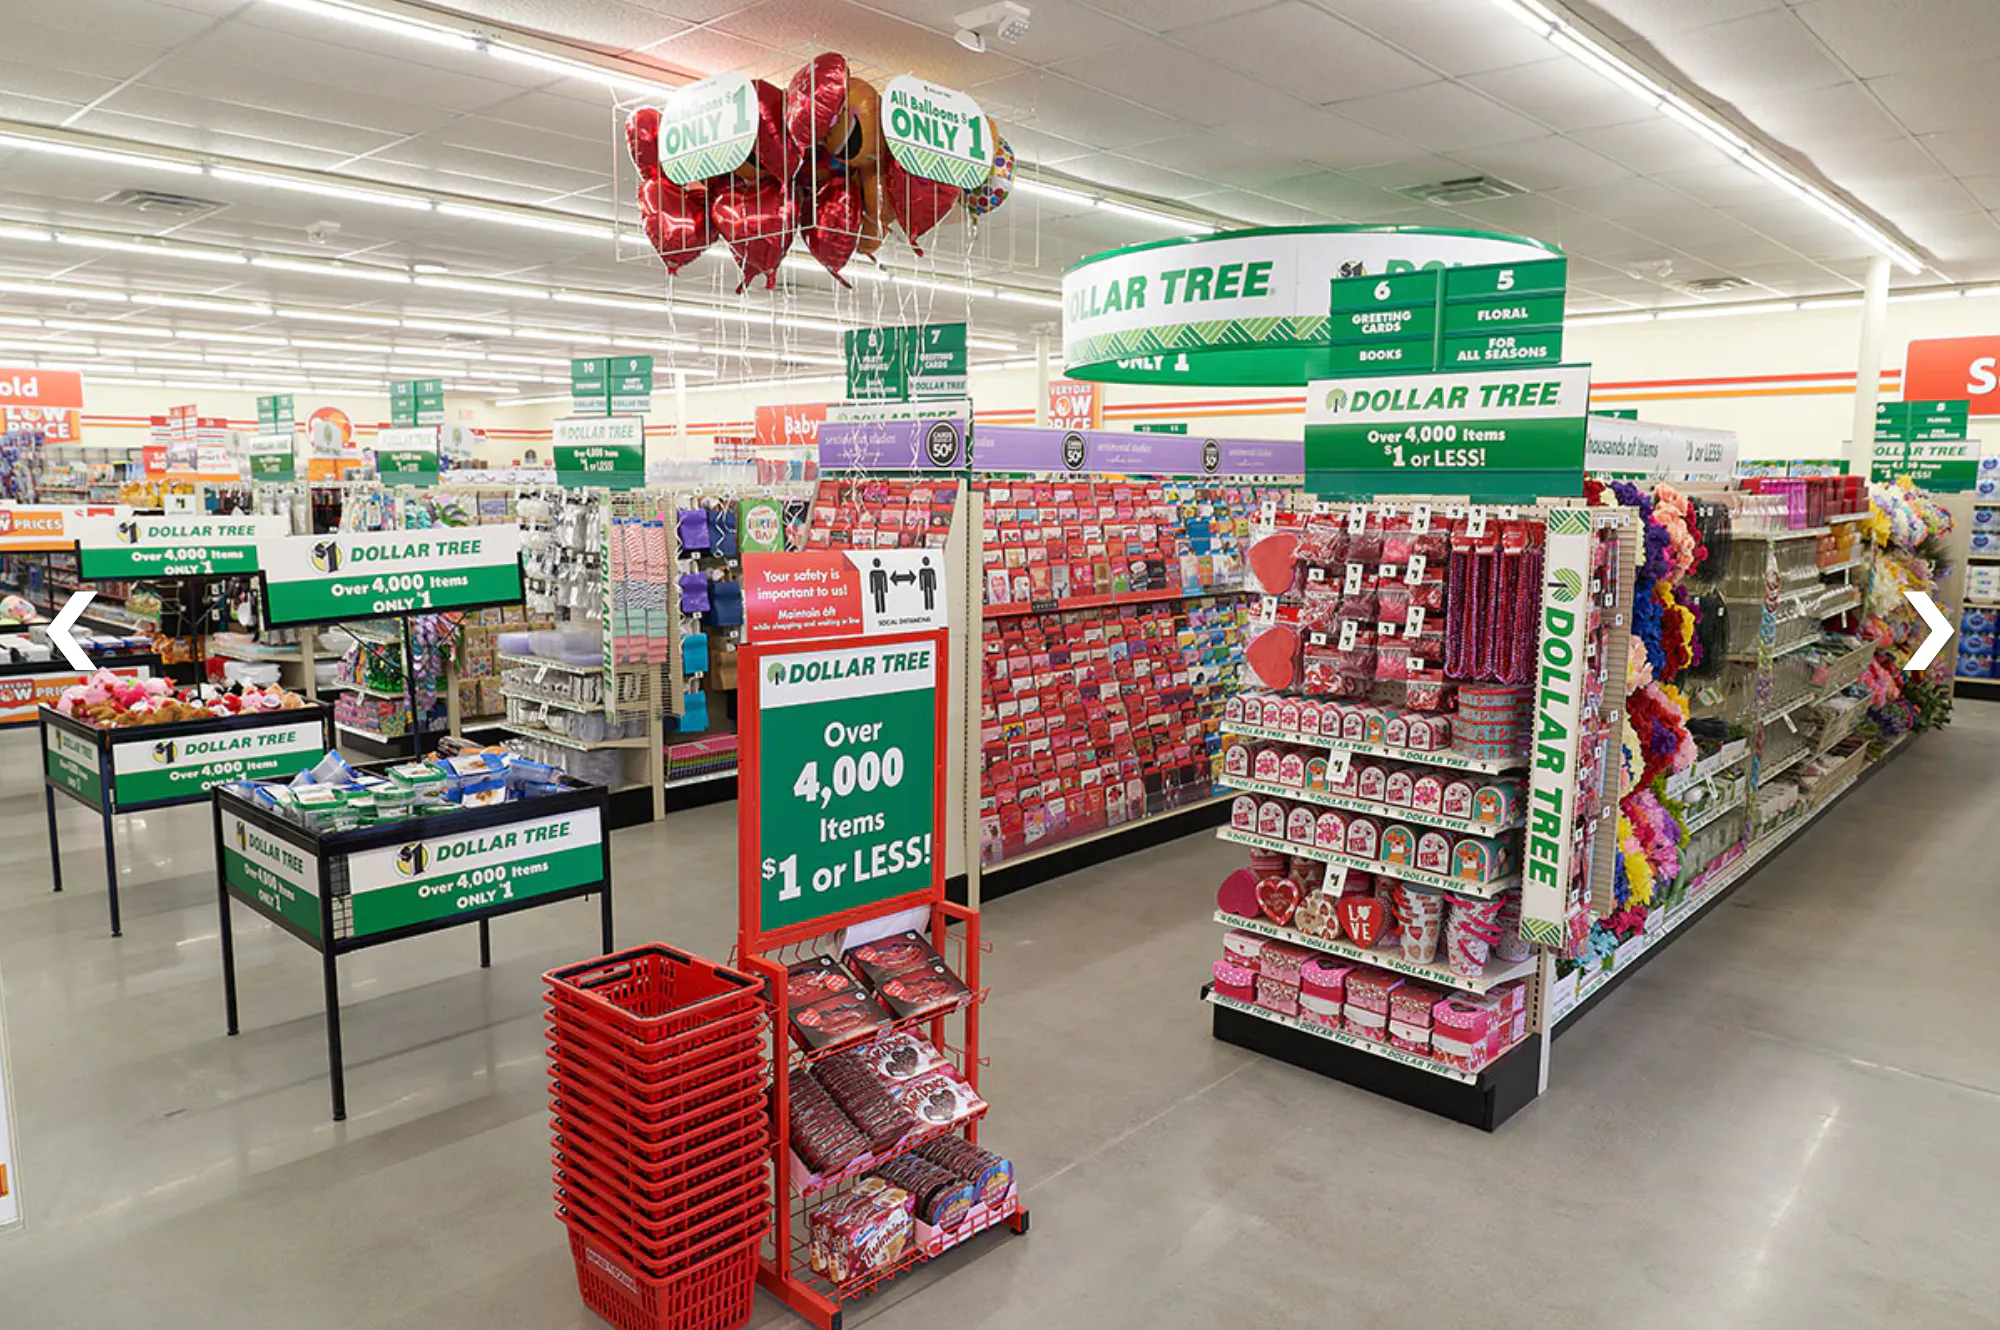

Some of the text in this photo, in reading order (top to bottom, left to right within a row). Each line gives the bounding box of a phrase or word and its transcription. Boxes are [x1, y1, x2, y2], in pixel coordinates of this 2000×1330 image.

[890, 90, 908, 107] All
[911, 96, 959, 124] Balloons
[666, 85, 750, 154] ONLY $1
[891, 108, 985, 161] ONLY $1
[1497, 270, 1515, 291] 5
[1068, 261, 1273, 325] OLLAR TREE
[1374, 282, 1391, 300] 6
[1352, 311, 1411, 325] GREETING
[1478, 308, 1528, 321] FLORAL
[930, 330, 941, 344] 7
[1362, 322, 1401, 334] CARDS
[1489, 338, 1516, 349] FOR
[1360, 350, 1402, 361] BOOKS
[1457, 346, 1548, 362] ALL SEASONS
[630, 360, 638, 372] 9
[924, 361, 948, 369] CARDS
[916, 382, 966, 390] DOLLAR TREE
[1966, 358, 1998, 395] S
[1048, 396, 1091, 417] LOW
[1350, 382, 1562, 413] DOLLAR TREE
[568, 425, 634, 440] DOLLAR TREE
[785, 416, 820, 440] Baby
[1368, 426, 1506, 446] Over 4,000 Items
[1588, 433, 1626, 456] housands
[1627, 435, 1637, 456] of
[1930, 446, 1967, 456] TREE
[1384, 445, 1486, 467] $1 or LESS!
[14, 518, 63, 531] PRICES
[148, 525, 211, 538] DOLLAR
[218, 524, 256, 536] TREE
[132, 548, 244, 562] Over 4,000 Items
[314, 540, 482, 573] $1 DOLLAR TREE
[164, 566, 199, 575] ONLY
[763, 568, 840, 583] Your safety is
[331, 574, 468, 597] Over 4,000 Items
[757, 584, 848, 602] important to us!
[373, 599, 415, 613] ONLY
[778, 606, 836, 620] Maintain 6ft
[752, 616, 861, 632] while shopping and waiting in line
[878, 616, 932, 627] SOCIAL DISTANCING
[789, 650, 931, 684] DOLLAR TREE
[36, 686, 71, 698] PRIC
[185, 736, 251, 756] DOLLAR
[259, 731, 297, 745] TREE
[824, 720, 883, 748] Over
[1316, 737, 1374, 753] DOLLAR TREE
[1528, 607, 1575, 889] DOLLAR TREE
[1406, 752, 1470, 768] DOLLAR TREE
[169, 759, 278, 782] Over 4,000 Items
[793, 748, 904, 810] 4,000
[1316, 794, 1373, 812] DOLLAR TREE
[820, 812, 885, 842] Items
[1405, 812, 1470, 830] DOLLAR TREE
[248, 832, 304, 875] DOLLAR TREE
[400, 822, 572, 877] $1 DOLLAR TREE
[762, 833, 932, 902] $1 or LESS!
[1315, 851, 1371, 869] DOLLAR TREE
[418, 861, 549, 899] Over 4,000 Items
[1403, 870, 1466, 891] DOLLAR TREE
[457, 890, 496, 910] ONLY
[1306, 939, 1364, 959] DOLLAR TREE
[1394, 962, 1457, 985] DOLLAR TREE
[861, 1220, 905, 1268] Twinkies
